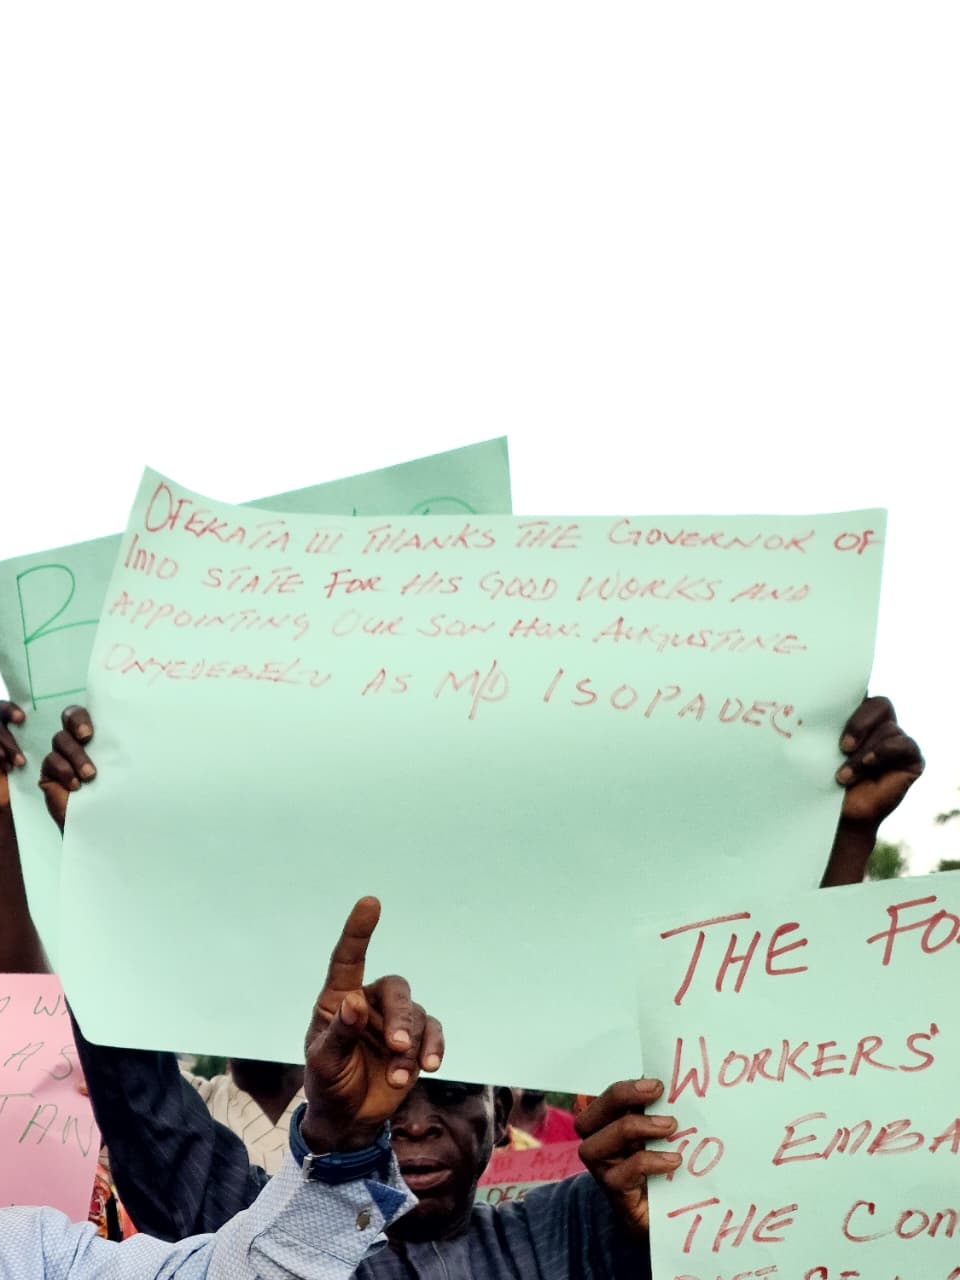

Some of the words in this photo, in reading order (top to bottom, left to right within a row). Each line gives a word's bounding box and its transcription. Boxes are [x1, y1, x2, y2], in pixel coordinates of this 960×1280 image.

[362, 523, 496, 554] THANKS
[516, 520, 582, 549] THE
[608, 518, 816, 554] GOVERNOR
[834, 529, 881, 555] OF
[124, 533, 179, 580] IMO
[201, 566, 304, 595] STATE
[323, 568, 384, 599] FOR
[401, 571, 463, 597] HIS
[479, 570, 559, 601] GOOD
[576, 568, 723, 602] WORKS
[730, 582, 810, 603] AND
[109, 591, 309, 641] APPOINTING
[332, 607, 407, 637] OUR
[416, 613, 495, 637] SON
[362, 667, 413, 696] AS
[659, 911, 809, 1006] THE
[866, 895, 960, 966] FO
[666, 1197, 799, 1254] THE
